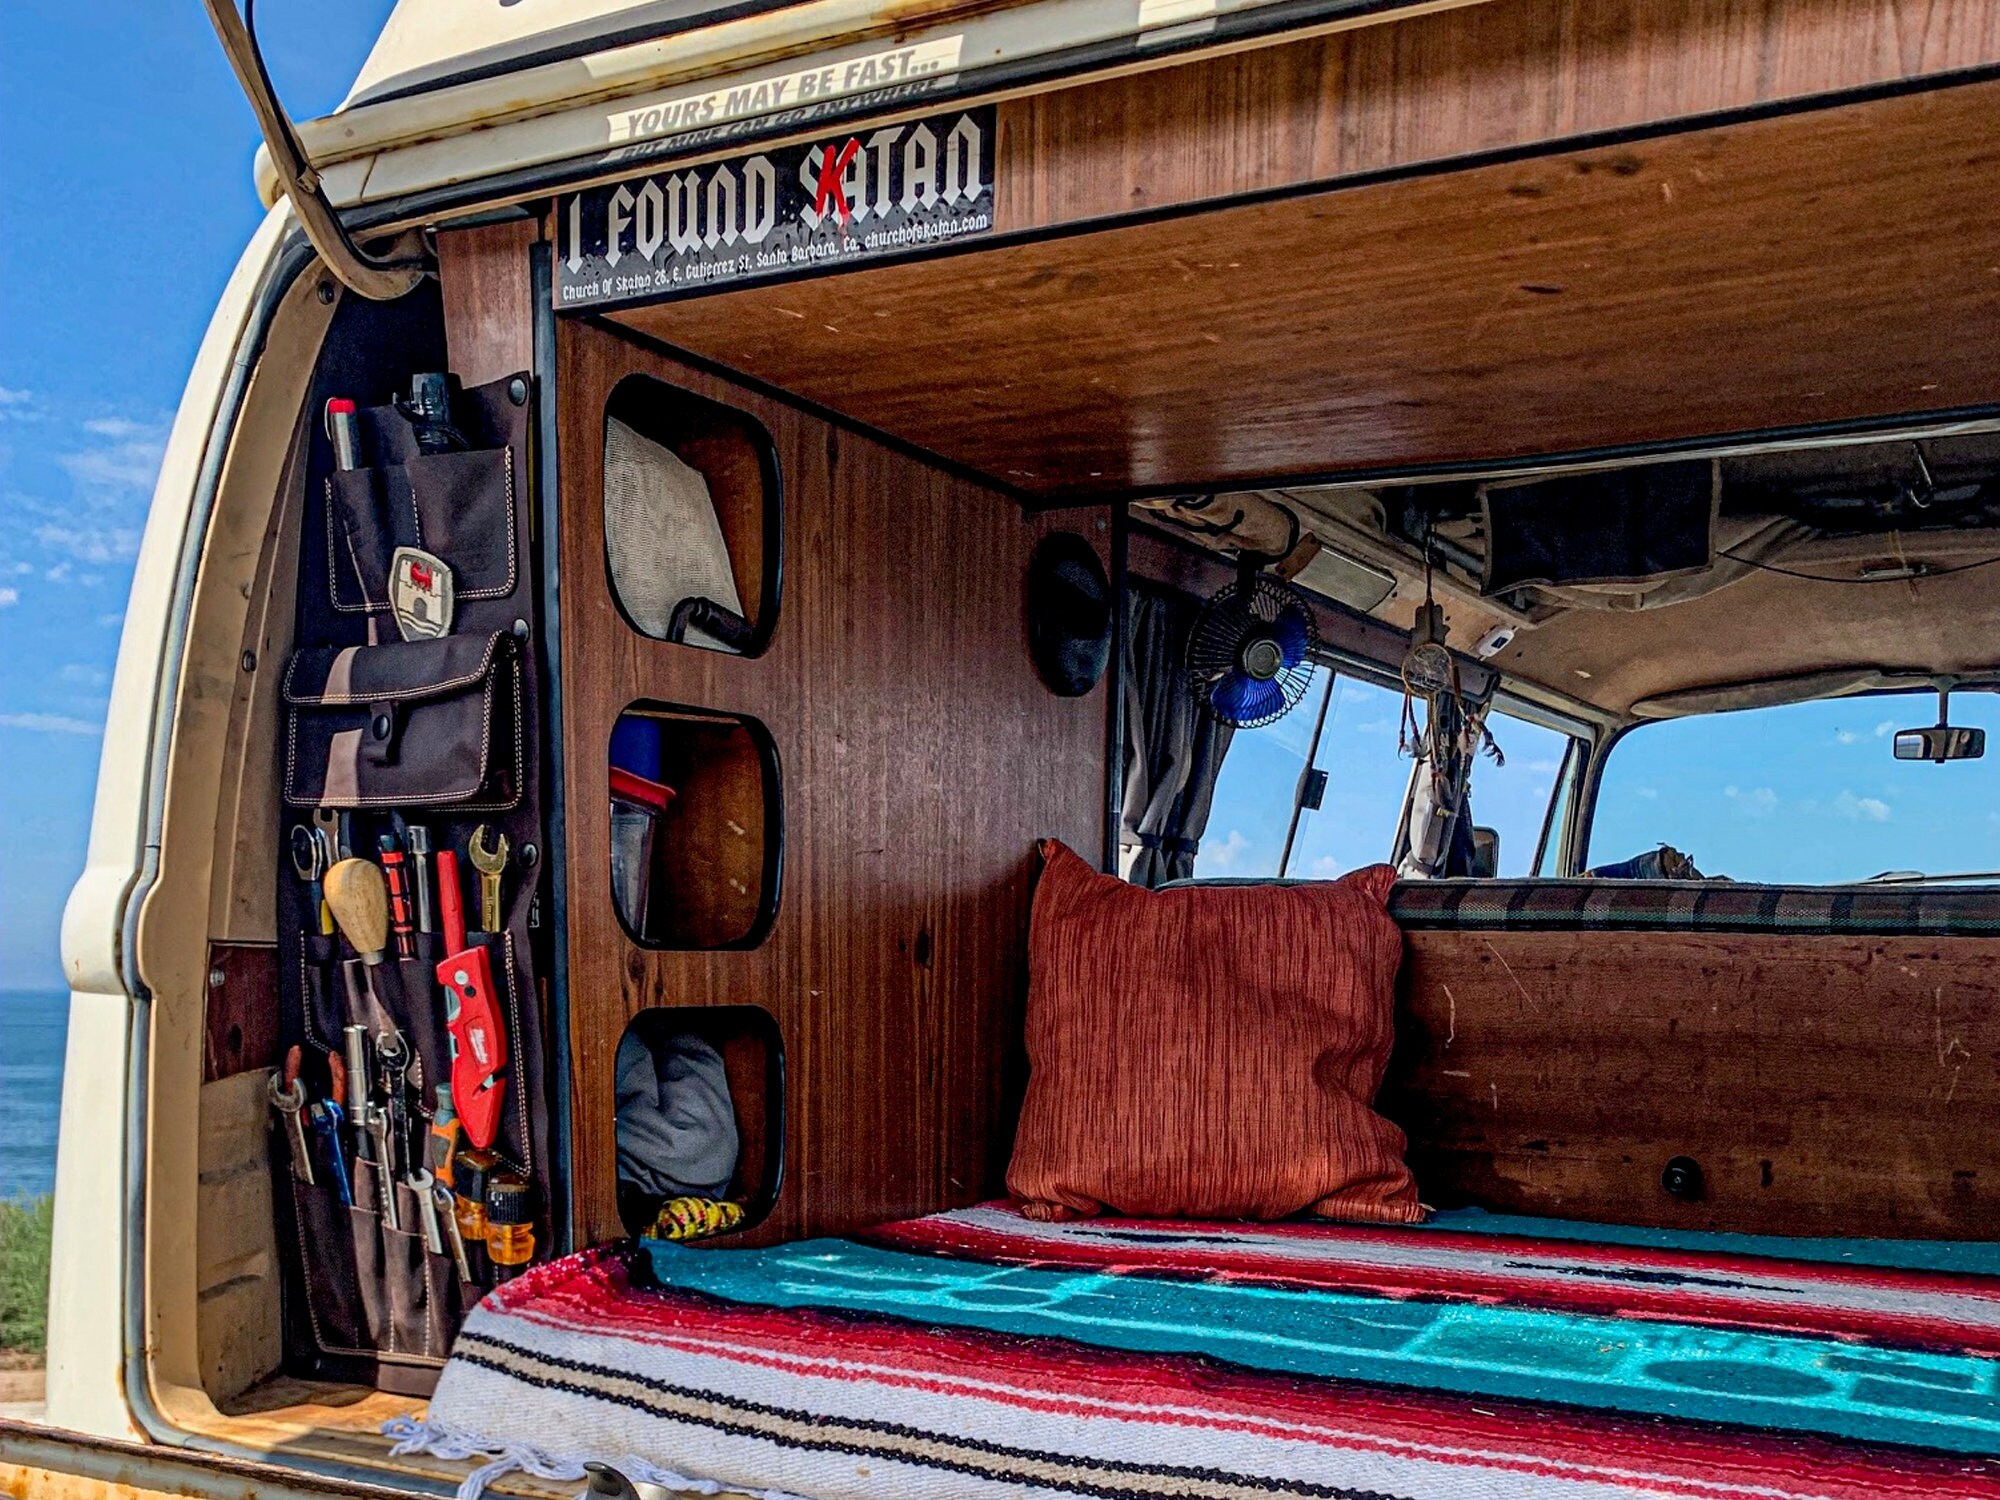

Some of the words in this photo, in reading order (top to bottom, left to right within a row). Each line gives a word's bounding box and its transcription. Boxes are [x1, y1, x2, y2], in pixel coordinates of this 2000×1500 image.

[628, 96, 717, 137] YOURS
[723, 79, 790, 118] MAY
[797, 69, 835, 98] BE
[843, 50, 939, 89] FAST...
[563, 281, 599, 300] Church
[616, 274, 651, 292] Skatan
[686, 259, 734, 280] Gutierrez
[738, 254, 752, 271] St.
[756, 249, 787, 267] Santa
[864, 213, 987, 248] churchofskatan.com
[566, 193, 583, 274] I
[605, 155, 775, 268] FOUND
